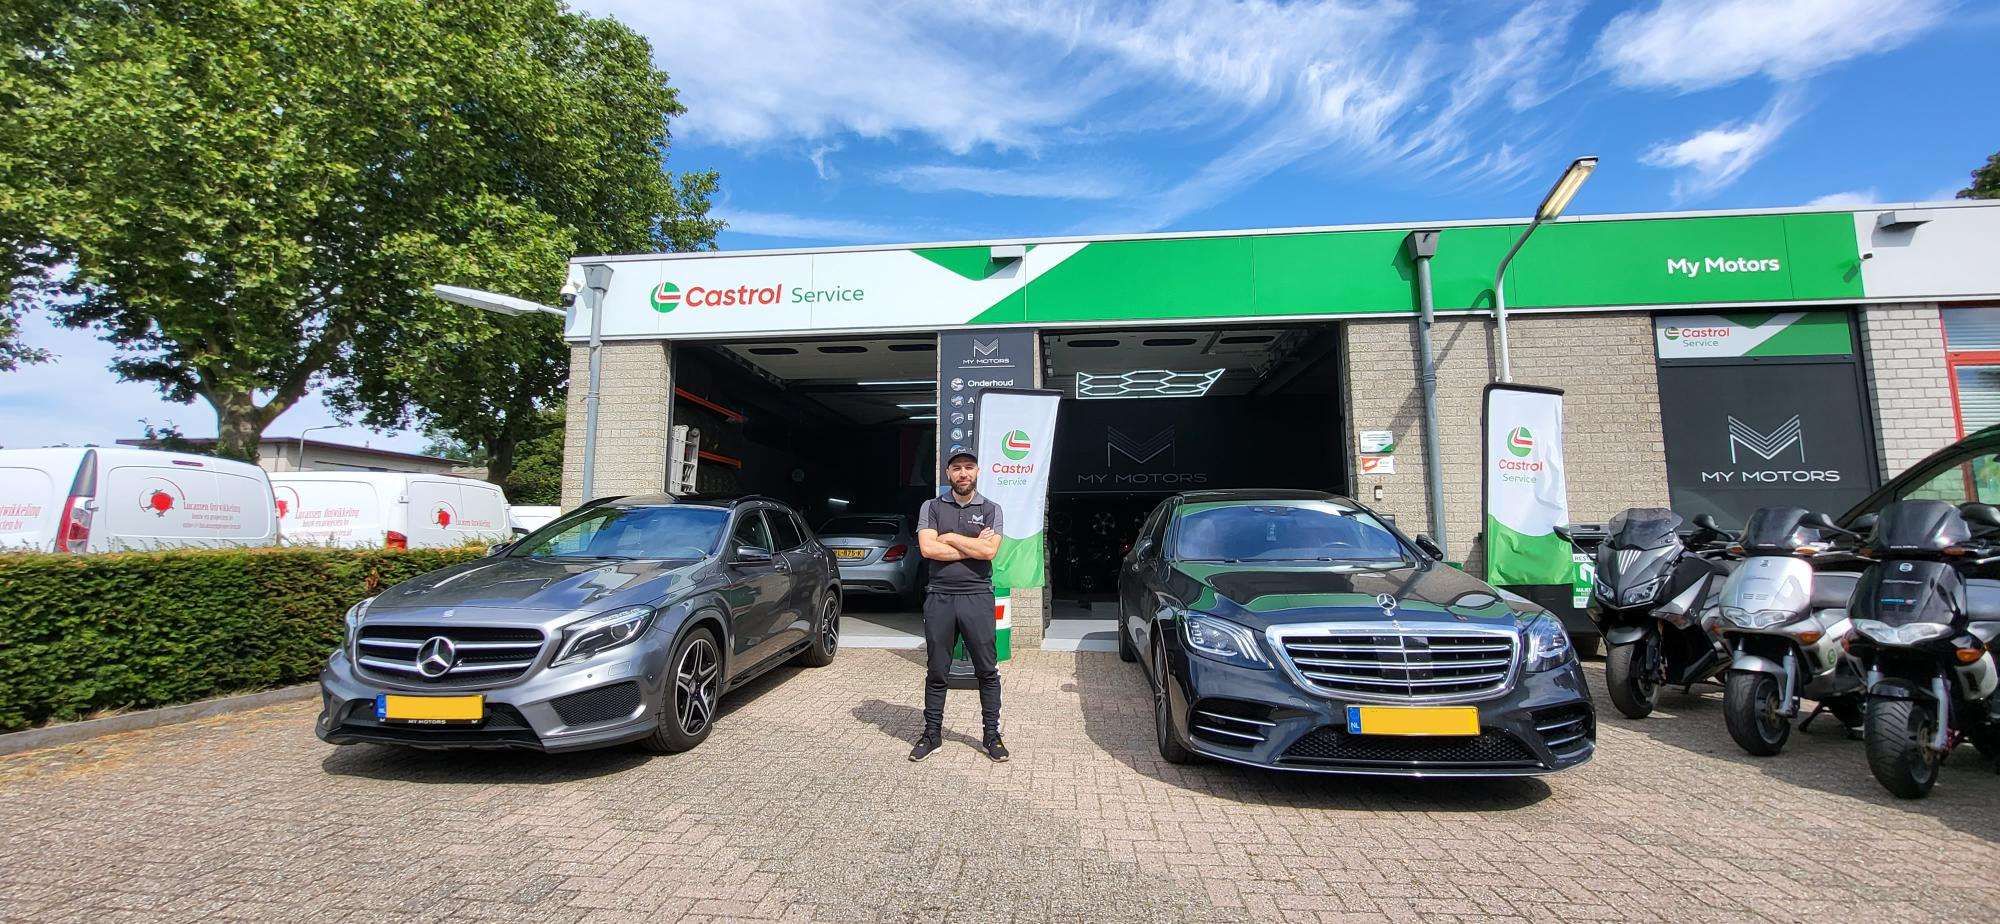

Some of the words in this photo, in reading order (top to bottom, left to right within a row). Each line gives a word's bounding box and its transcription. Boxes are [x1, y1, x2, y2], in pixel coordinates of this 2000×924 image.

[1667, 258, 1700, 278] My
[1704, 256, 1780, 273] Motors
[685, 283, 783, 308] Castrol
[791, 285, 865, 304] Service
[1682, 327, 1730, 338] Castrol
[1682, 339, 1719, 348] Service
[967, 379, 1014, 388] Onderhoud
[991, 462, 1035, 474] Castrol
[1498, 458, 1544, 473] Castrol
[996, 476, 1028, 487] Service
[1077, 473, 1111, 484] MY
[1115, 473, 1208, 484] MOTORS
[1502, 473, 1538, 484] Service
[1701, 471, 1735, 483] MY
[1742, 470, 1841, 483] MOTORS
